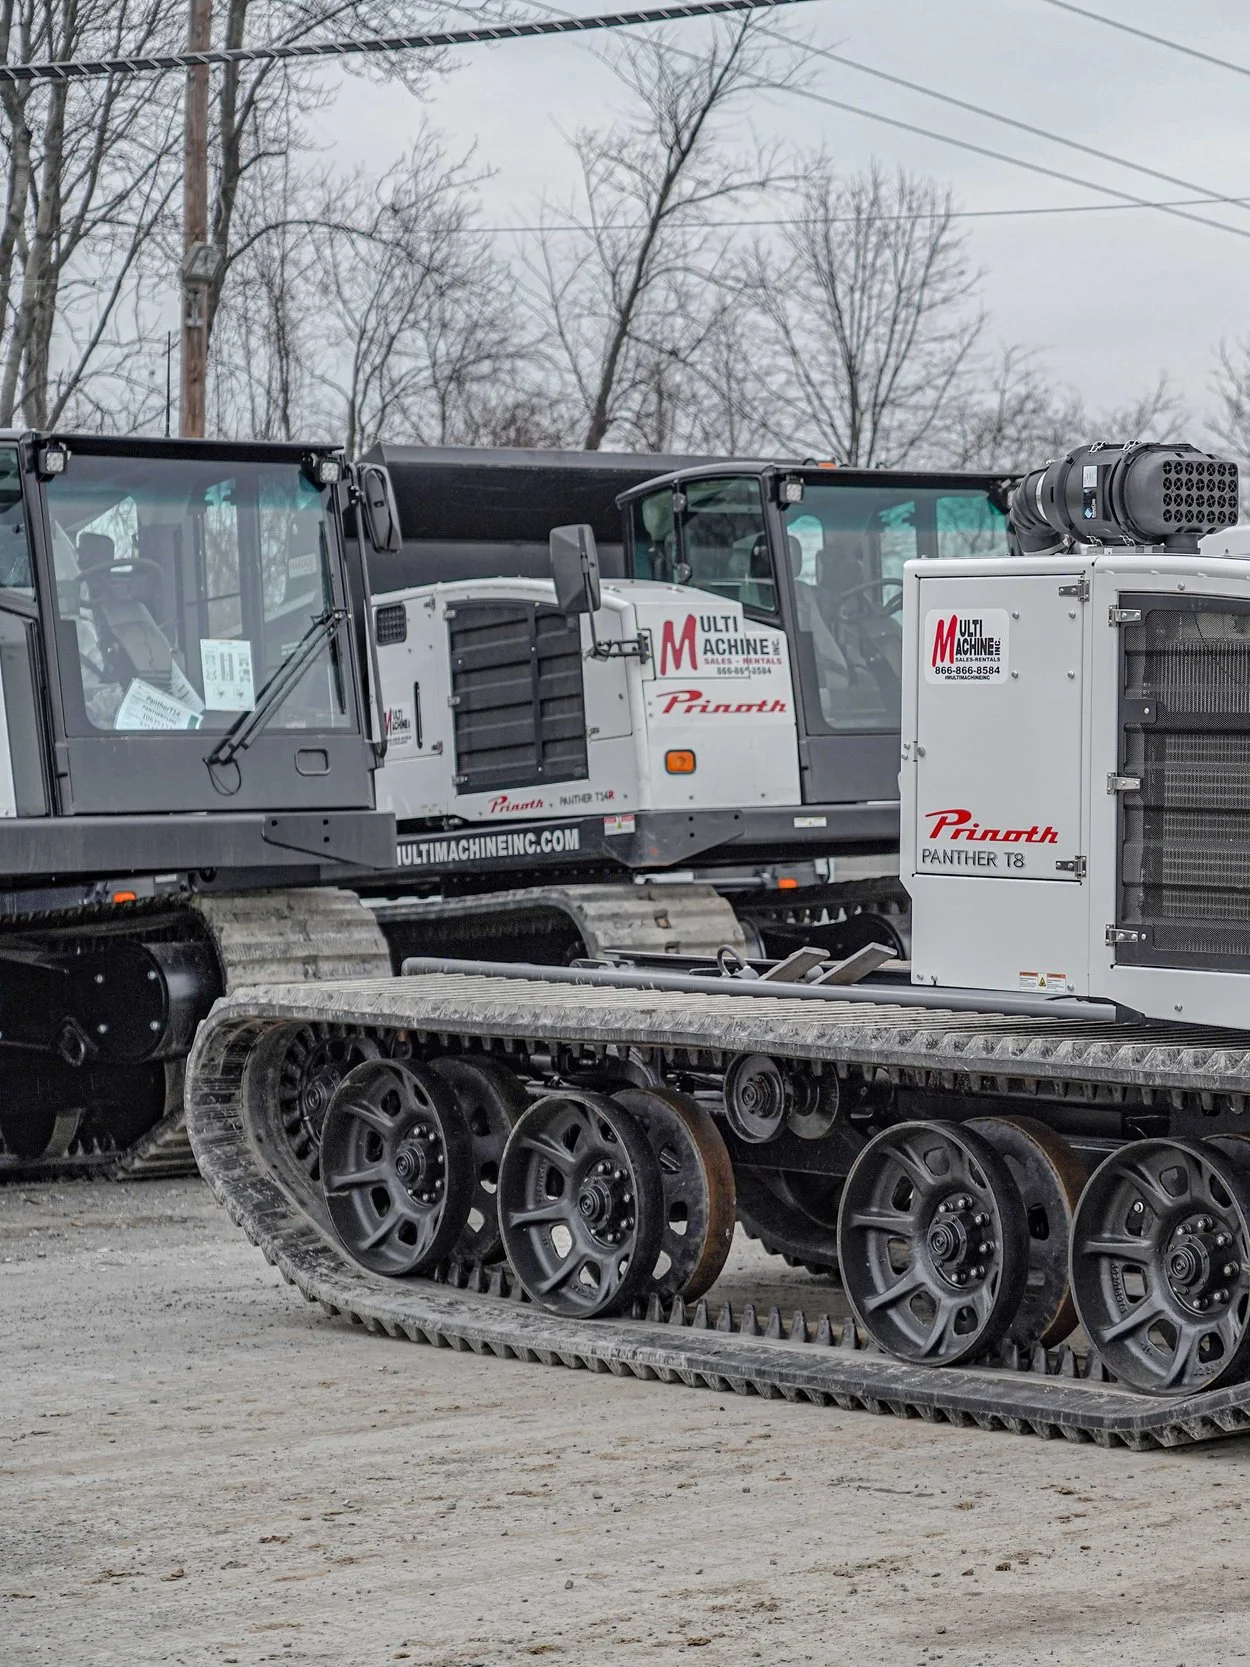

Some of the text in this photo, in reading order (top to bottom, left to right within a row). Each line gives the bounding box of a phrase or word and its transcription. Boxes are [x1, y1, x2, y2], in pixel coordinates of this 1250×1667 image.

[704, 657, 733, 665] SALES
[743, 657, 782, 665] RENTALS
[934, 666, 1001, 675] 866-866-8584
[656, 689, 786, 714] Prinoth
[559, 793, 592, 806] PANTHER
[925, 809, 1058, 844] Prinoth
[397, 828, 579, 866] ULTIMACHINEINC.COM
[922, 848, 1025, 868] PANTHER T8
